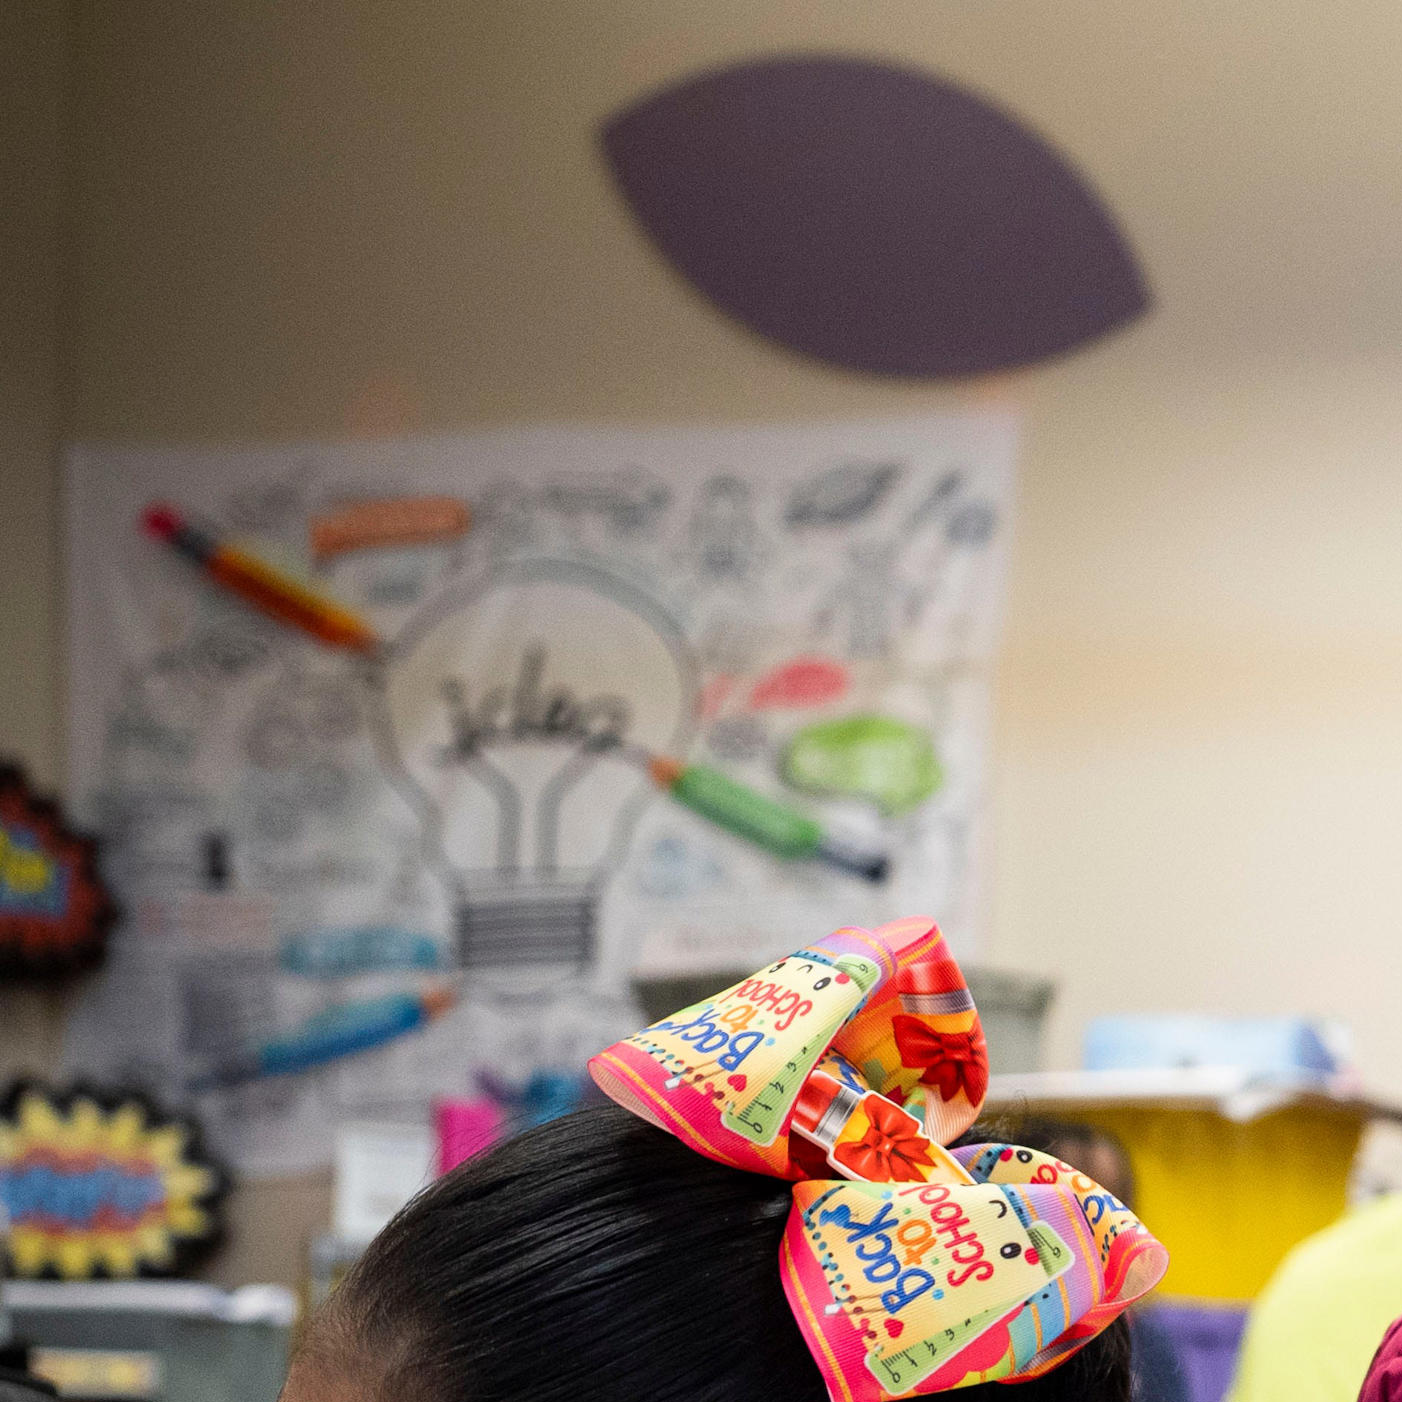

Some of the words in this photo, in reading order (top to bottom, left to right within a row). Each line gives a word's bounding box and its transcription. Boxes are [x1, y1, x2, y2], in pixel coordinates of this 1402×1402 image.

[668, 1008, 765, 1072] Back
[720, 1004, 758, 1034] to
[845, 1202, 936, 1315] Back
[897, 1218, 937, 1266] to
